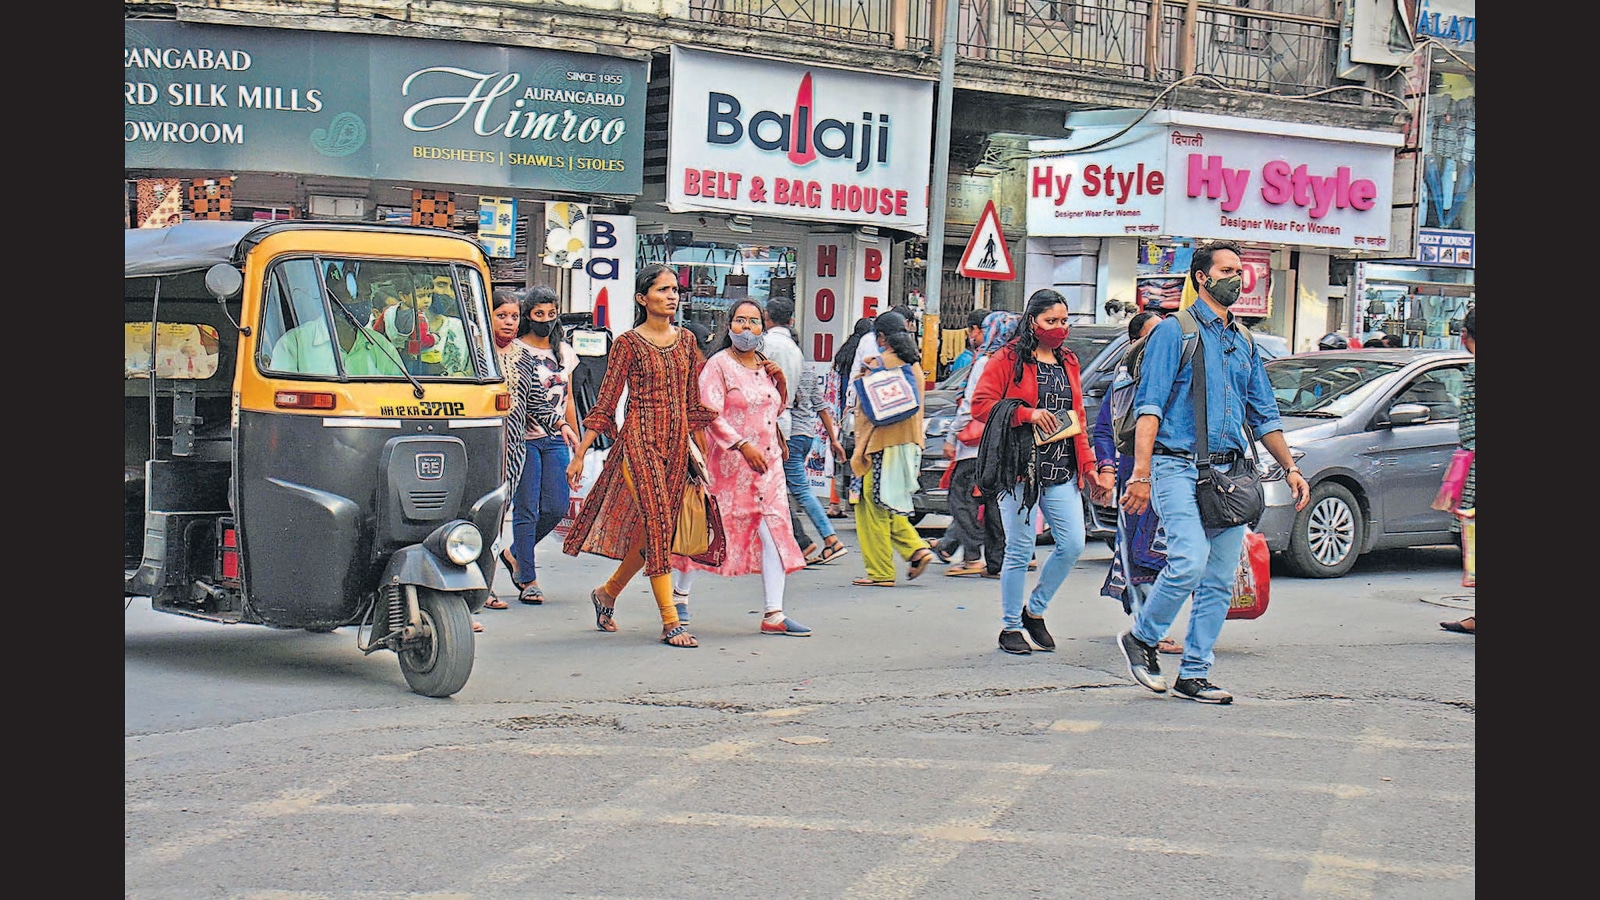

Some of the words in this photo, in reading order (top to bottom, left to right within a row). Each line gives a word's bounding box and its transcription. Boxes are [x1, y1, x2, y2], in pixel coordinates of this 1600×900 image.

[566, 71, 597, 83] SINCE
[598, 74, 623, 85] 1955
[168, 83, 229, 108] SILK
[238, 85, 323, 113] MILLS
[401, 66, 627, 145] Himroo
[523, 87, 626, 107] AURANGABAD
[125, 121, 245, 145] OWROOM
[706, 91, 890, 173] Balaji
[1171, 131, 1204, 148] दिपाली
[413, 146, 495, 163] BEDSHEETS
[508, 153, 565, 168] SHAWLS
[577, 158, 625, 172] STOLES
[684, 167, 742, 200] BELT
[749, 176, 767, 203] &
[774, 177, 822, 208] BAG
[831, 183, 908, 216] HOUSE
[1032, 166, 1072, 206] Hy
[1082, 163, 1165, 205] Style
[1186, 153, 1251, 212] Hy
[1260, 160, 1377, 219] Style
[1054, 210, 1084, 219] Designer
[1085, 210, 1102, 218] Wear
[1103, 209, 1115, 217] For
[1116, 209, 1142, 217] Women
[1220, 215, 1263, 231] Designer
[1264, 219, 1288, 231] Wear
[1290, 221, 1306, 233] For
[1307, 222, 1341, 236] Women
[1235, 295, 1262, 306] ount
[381, 406, 394, 416] MH
[395, 406, 406, 416] 12
[419, 402, 466, 416] 3702
[421, 462, 441, 474] RE
